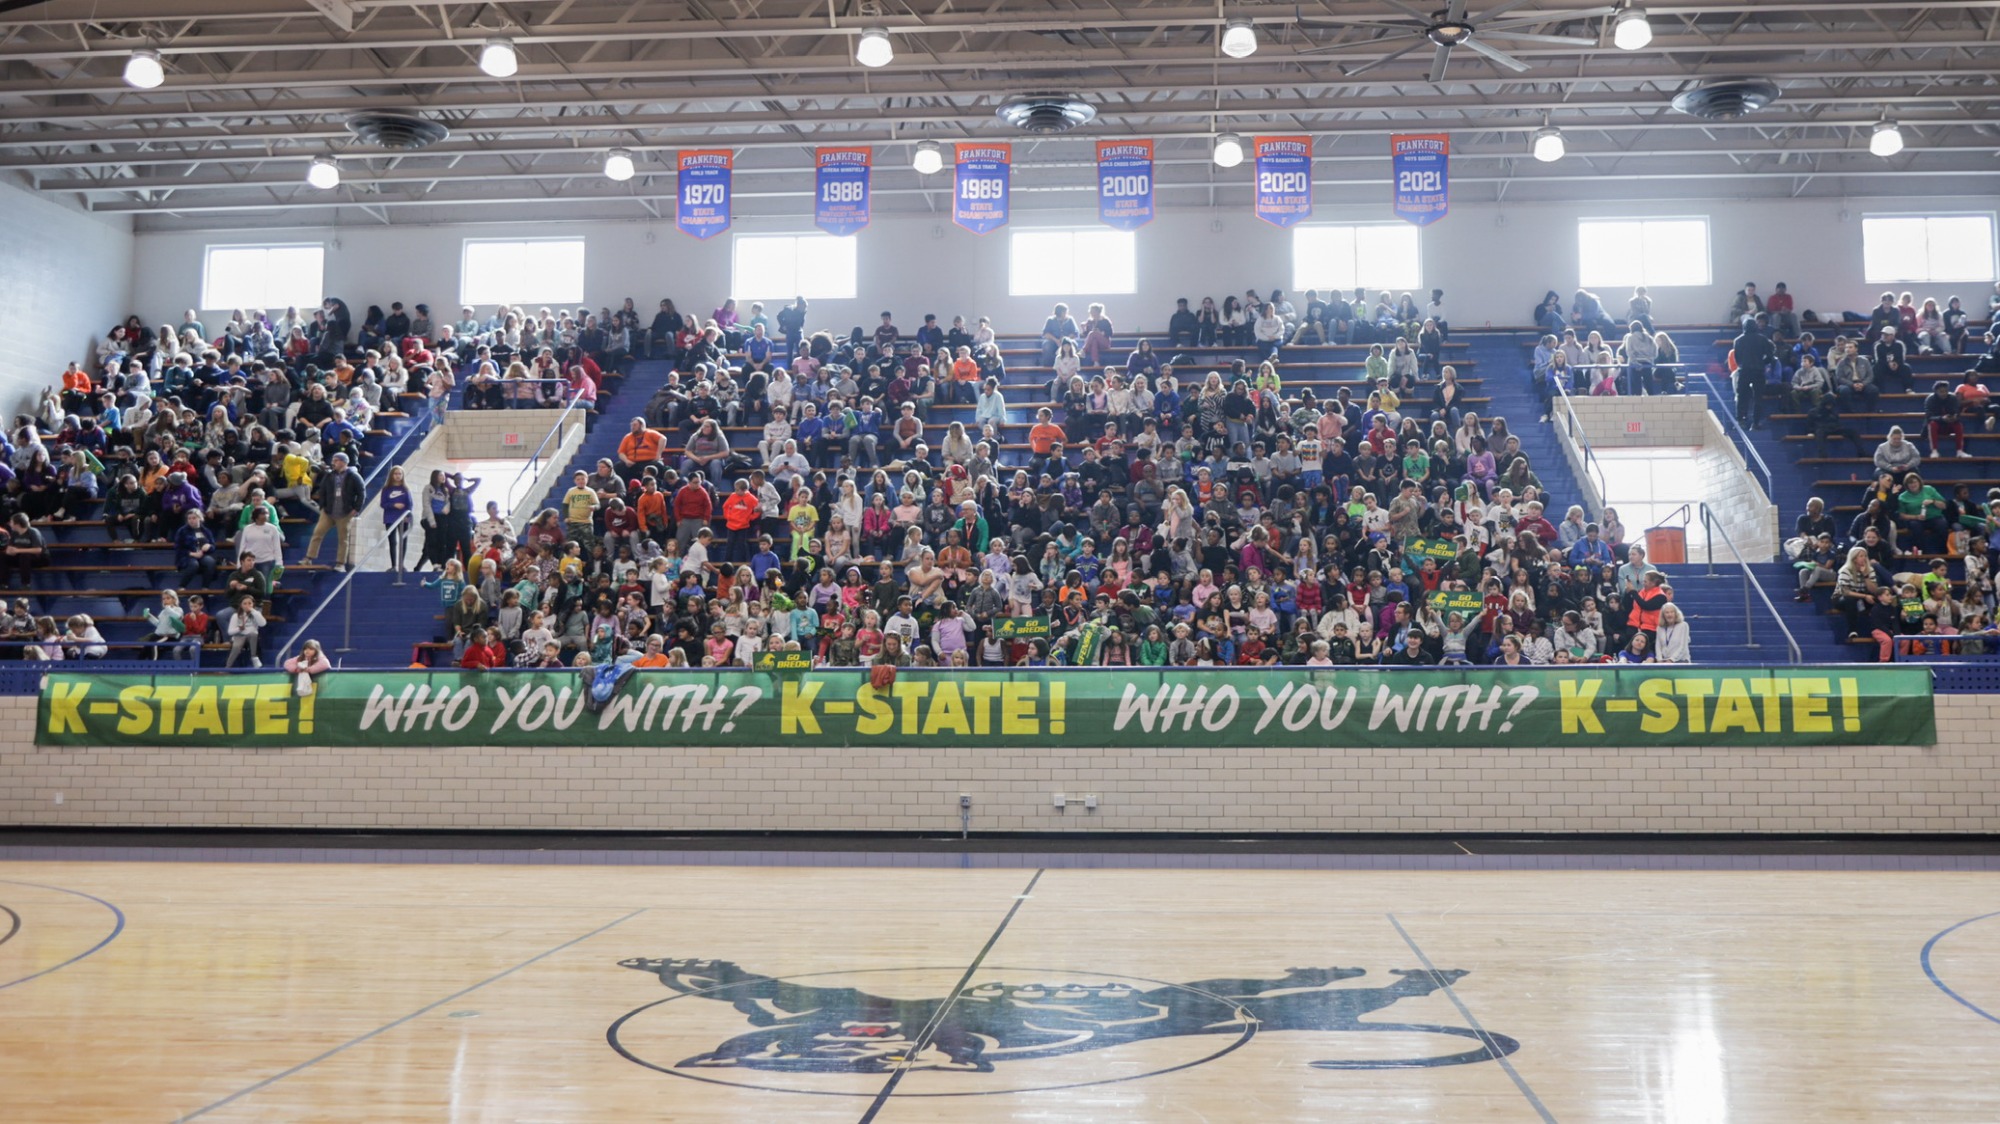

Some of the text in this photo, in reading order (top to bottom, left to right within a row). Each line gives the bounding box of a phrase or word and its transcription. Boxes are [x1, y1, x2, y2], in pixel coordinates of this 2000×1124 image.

[1101, 146, 1148, 158] FRANKFORT
[1260, 142, 1307, 154] FRANKFORT
[1396, 140, 1444, 152] FRANKFORT
[682, 154, 728, 166] FRANKFORT
[820, 152, 867, 164] FRANKFORT
[959, 149, 1006, 160] FRANKFORT
[1103, 175, 1149, 197] 2000
[1260, 172, 1307, 193] 2020
[1400, 171, 1442, 192] 2021
[684, 184, 724, 205] 1970
[822, 181, 864, 202] 1988
[961, 179, 1003, 199] 1989
[1260, 196, 1275, 204] ALL
[1276, 196, 1282, 204] A
[1398, 195, 1413, 203] ALL
[1414, 195, 1420, 203] A
[1627, 422, 1641, 433] EXIT
[505, 433, 519, 444] EXIT
[1425, 547, 1456, 557] BREDS!
[1449, 600, 1482, 608] BREDS!
[1016, 626, 1049, 634] BREDS!
[1077, 630, 1093, 665] EFENSE!
[776, 660, 811, 668] BREDS!
[48, 677, 1861, 735] K-STATE! WHO YOU WITH? K-STATE! WHO YOU WITH? K-STATE!
